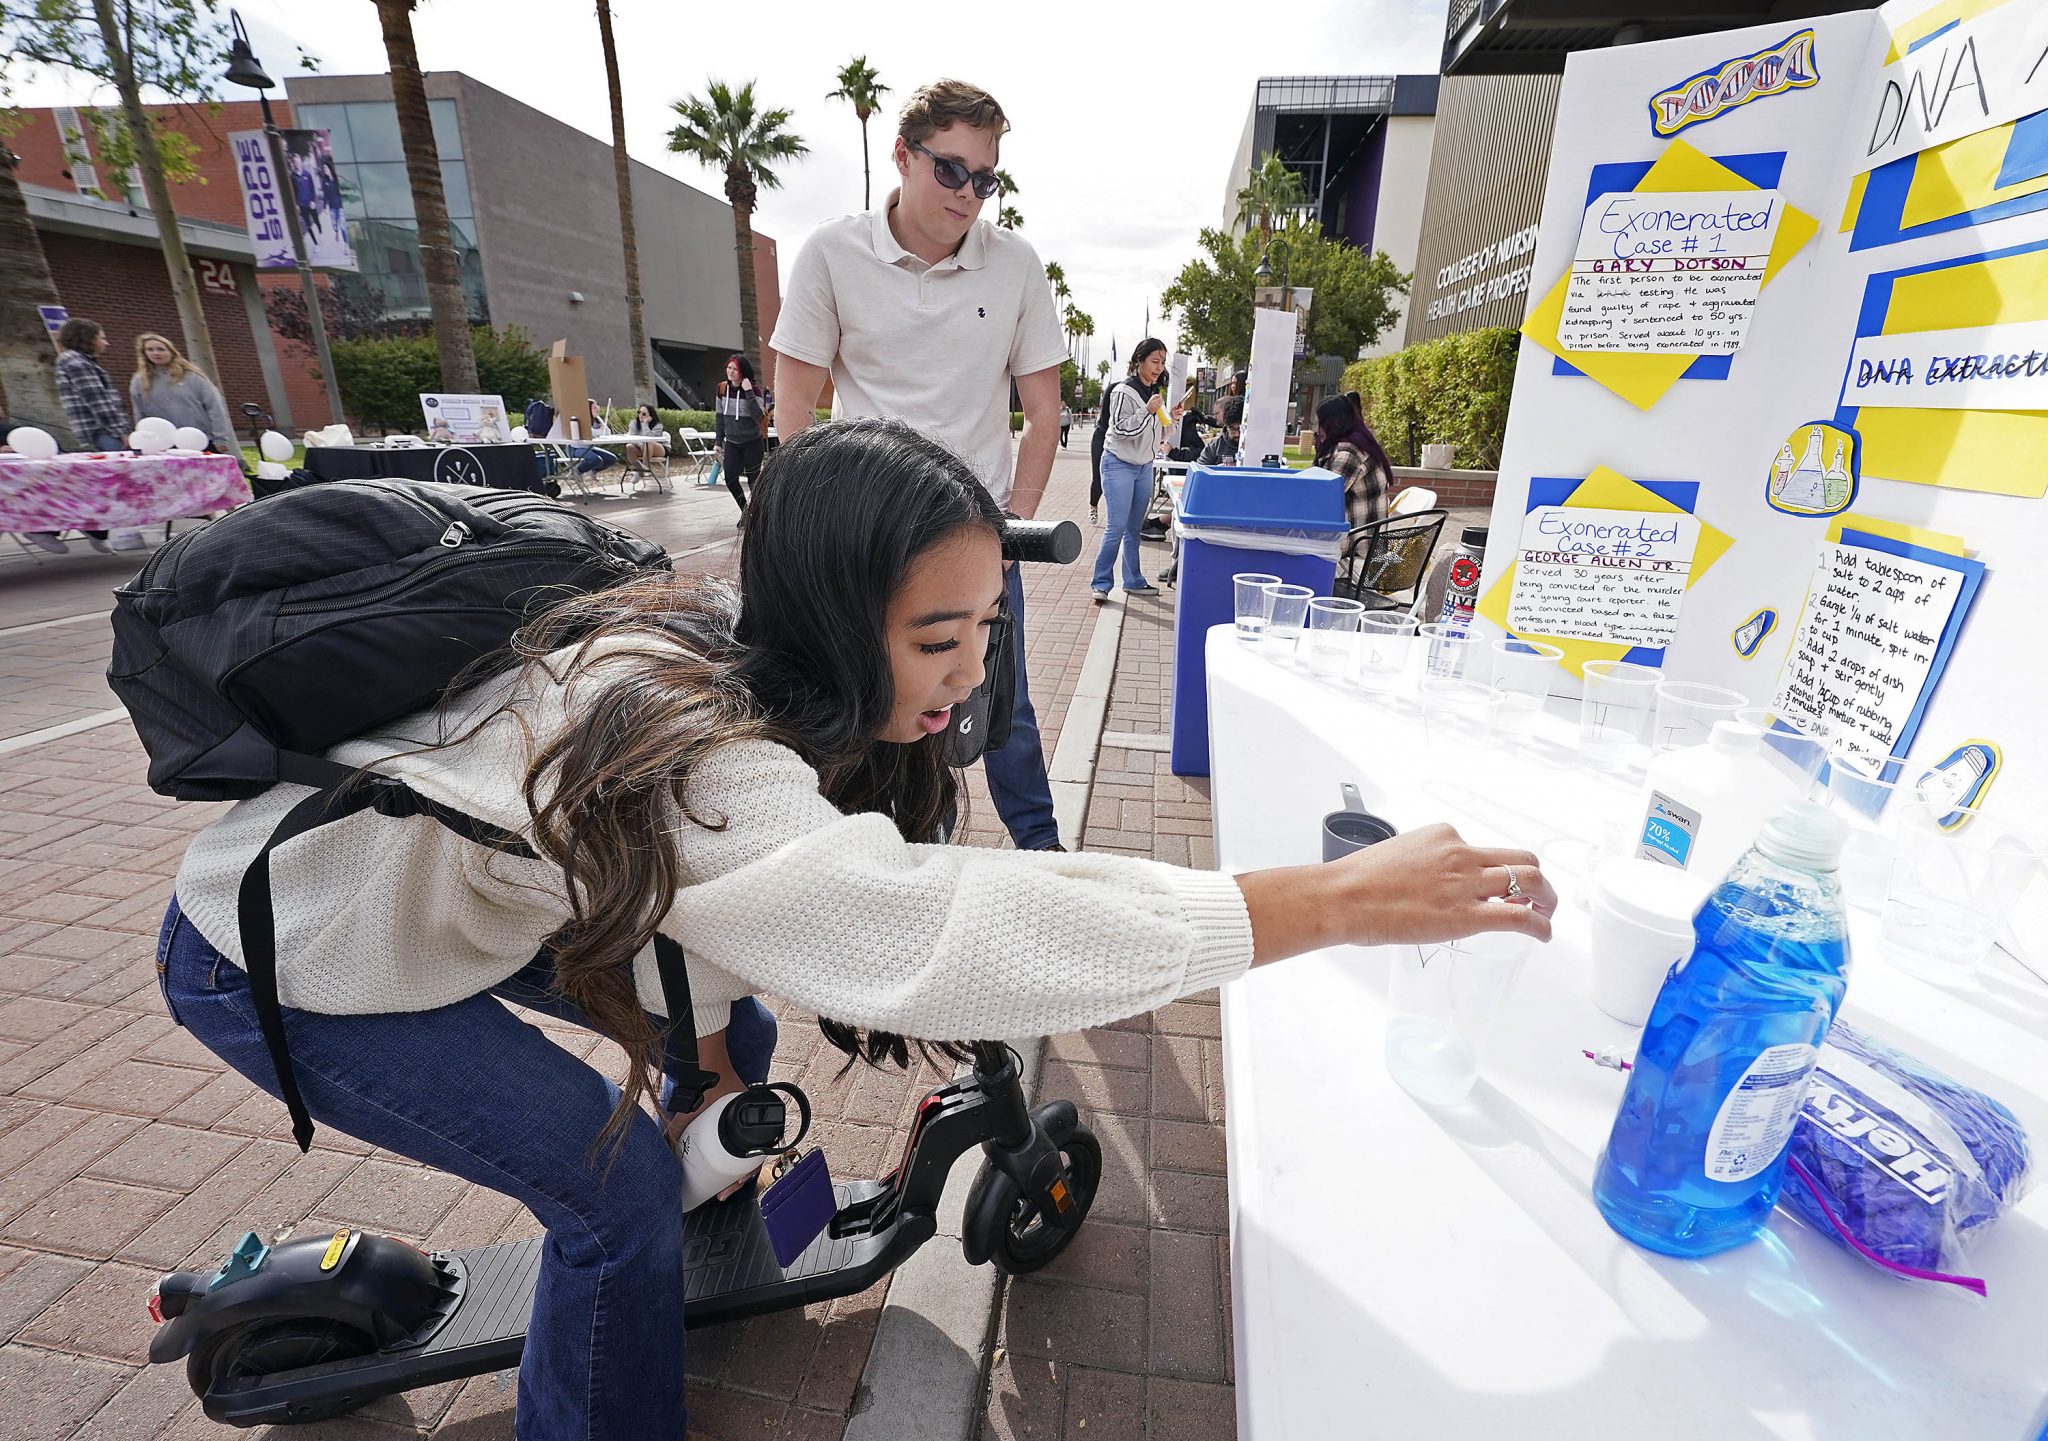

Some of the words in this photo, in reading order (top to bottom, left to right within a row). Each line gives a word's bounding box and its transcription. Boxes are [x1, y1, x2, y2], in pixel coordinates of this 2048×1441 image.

[1867, 36, 1989, 157] DNA
[236, 139, 271, 241] LOPE
[251, 139, 284, 240] SHOP
[1600, 199, 1773, 233] Exonerated
[1437, 252, 1479, 290] COLLEGE
[1480, 244, 1496, 272] OF
[1496, 224, 1540, 265] NURSIN
[1614, 232, 1673, 259] Case
[1681, 236, 1699, 253] #
[1709, 233, 1727, 252] 1
[199, 259, 235, 290] 24
[1593, 259, 1654, 272] GARY
[1675, 257, 1747, 270] DOTSON
[1574, 277, 1590, 285] The
[1598, 276, 1622, 285] first
[1630, 276, 1664, 285] person
[1711, 273, 1762, 281] exonerated
[1428, 294, 1457, 322] HEALTH
[1458, 283, 1486, 313] CARE
[1486, 265, 1531, 303] PROFES
[1568, 305, 1591, 313] found
[1601, 304, 1633, 316] guilty
[1702, 299, 1756, 311] aggravated
[1634, 316, 1685, 324] sentenced
[1711, 312, 1725, 320] 50
[1729, 313, 1747, 324] yrs.
[1619, 331, 1650, 339] Served
[1657, 329, 1688, 337] about
[1628, 342, 1649, 350] being
[1657, 340, 1704, 348] exonerated
[1539, 512, 1678, 544] Exonerated
[1558, 536, 1605, 555] Case
[1636, 544, 1655, 557] 2
[1523, 565, 1562, 577] Served
[1573, 569, 1588, 578] 30
[1595, 574, 1624, 583] years
[1634, 575, 1664, 583] after
[1525, 551, 1579, 564] GEORGE
[1591, 555, 1642, 568] ALLEN
[1652, 561, 1681, 571] JR.
[1836, 550, 1857, 568] Add
[1865, 558, 1923, 584] tablespoon
[1931, 577, 1947, 589] of
[1520, 581, 1543, 592] being
[1549, 582, 1595, 591] convicted
[1541, 595, 1570, 605] young
[1833, 568, 1854, 581] salt
[1859, 576, 1869, 587] to
[1873, 581, 1883, 593] 2
[1886, 587, 1905, 604] cups
[1915, 594, 1931, 606] of
[1604, 623, 1625, 632] type
[1653, 612, 1679, 620] false
[1820, 595, 1846, 617] Gargle
[1865, 614, 1876, 625] of
[1878, 618, 1898, 633] salt
[1904, 629, 1936, 646] water
[1609, 633, 1642, 644] January
[1810, 625, 1818, 635] to
[1822, 630, 1839, 645] cup
[1814, 613, 1828, 626] for
[1832, 621, 1840, 632] 1
[1889, 646, 1909, 659] spit
[1798, 650, 1815, 671] soap
[1835, 668, 1852, 683] stir
[1855, 678, 1885, 706] gently
[1807, 639, 1824, 657] Add
[1828, 650, 1837, 662] 2
[1841, 657, 1866, 676] drops
[1869, 668, 1880, 680] of
[1882, 672, 1904, 692] dish
[1785, 691, 1791, 700] 3
[1791, 694, 1823, 719] minutes
[1789, 681, 1814, 704] alcohol
[1817, 699, 1826, 710] to
[1796, 668, 1814, 687] Add
[1843, 696, 1855, 709] of
[1856, 702, 1893, 735] rubbing
[1649, 821, 1671, 841] 70%
[1806, 1078, 1950, 1192] Hefty
